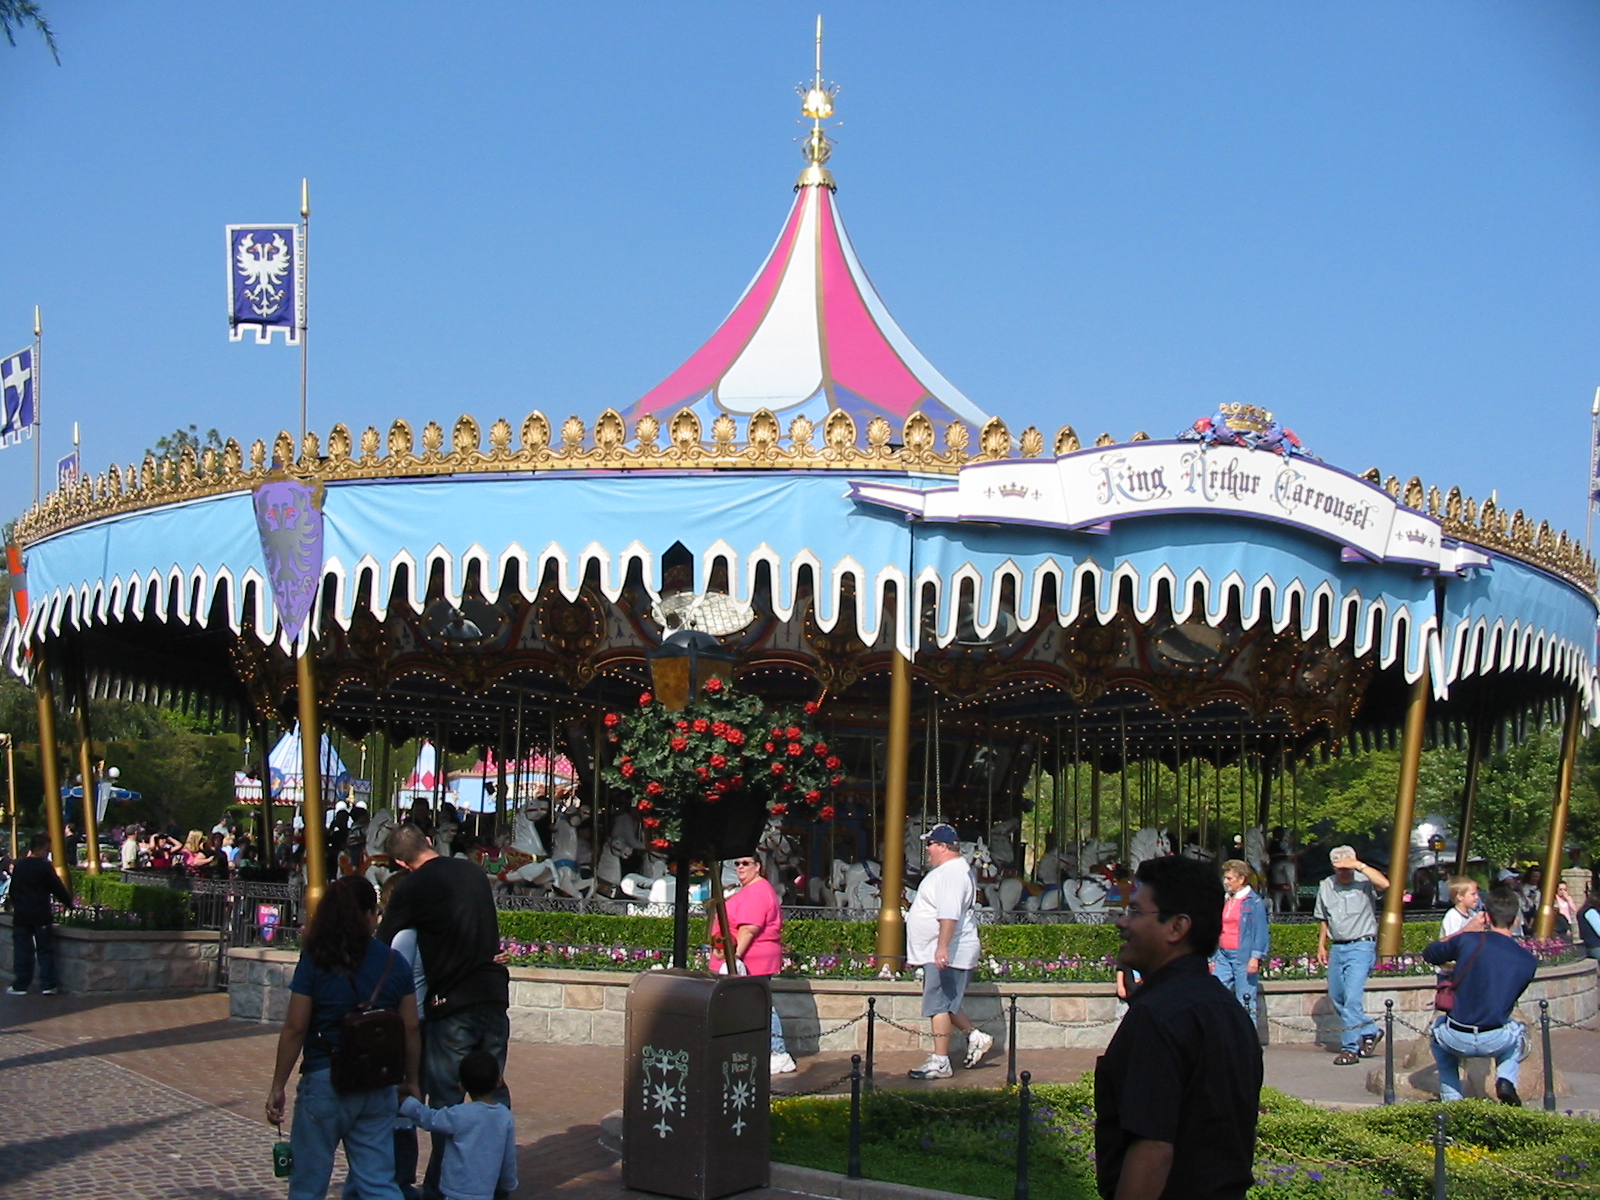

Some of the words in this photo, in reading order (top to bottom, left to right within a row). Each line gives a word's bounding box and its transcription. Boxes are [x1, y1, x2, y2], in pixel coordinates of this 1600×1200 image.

[1091, 452, 1172, 505] King
[1180, 449, 1261, 502] Arthur
[1270, 467, 1379, 530] Carrousel
